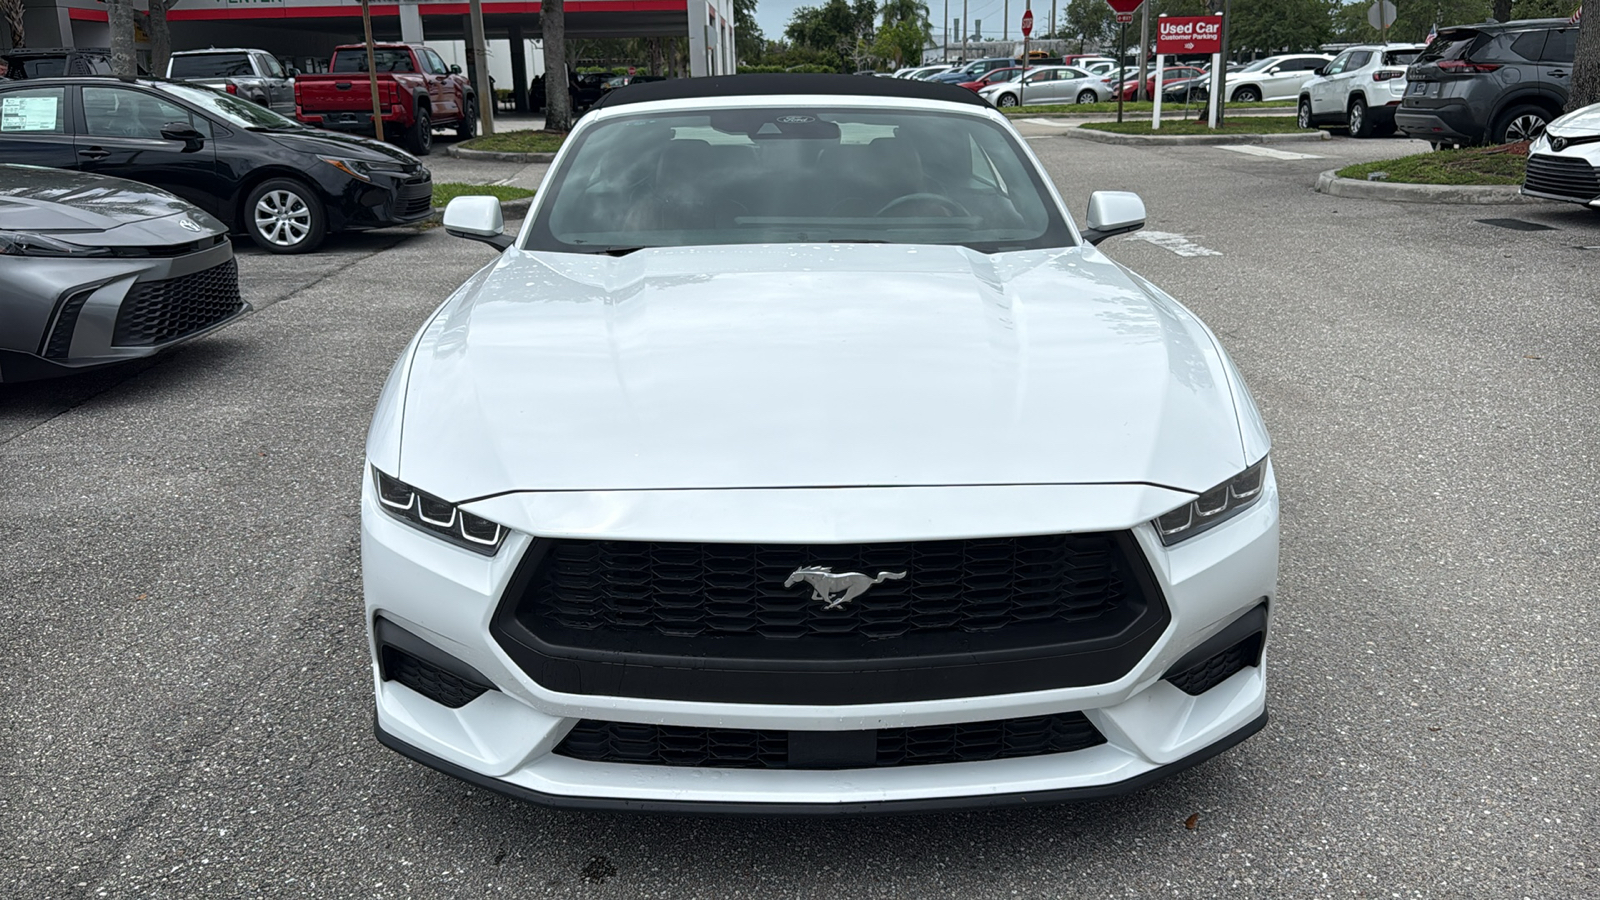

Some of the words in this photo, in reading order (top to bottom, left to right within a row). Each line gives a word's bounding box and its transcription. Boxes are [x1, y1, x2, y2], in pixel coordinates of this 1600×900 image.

[1160, 22, 1192, 34] Used
[1196, 22, 1220, 33] Car
[782, 115, 809, 123] Ford
